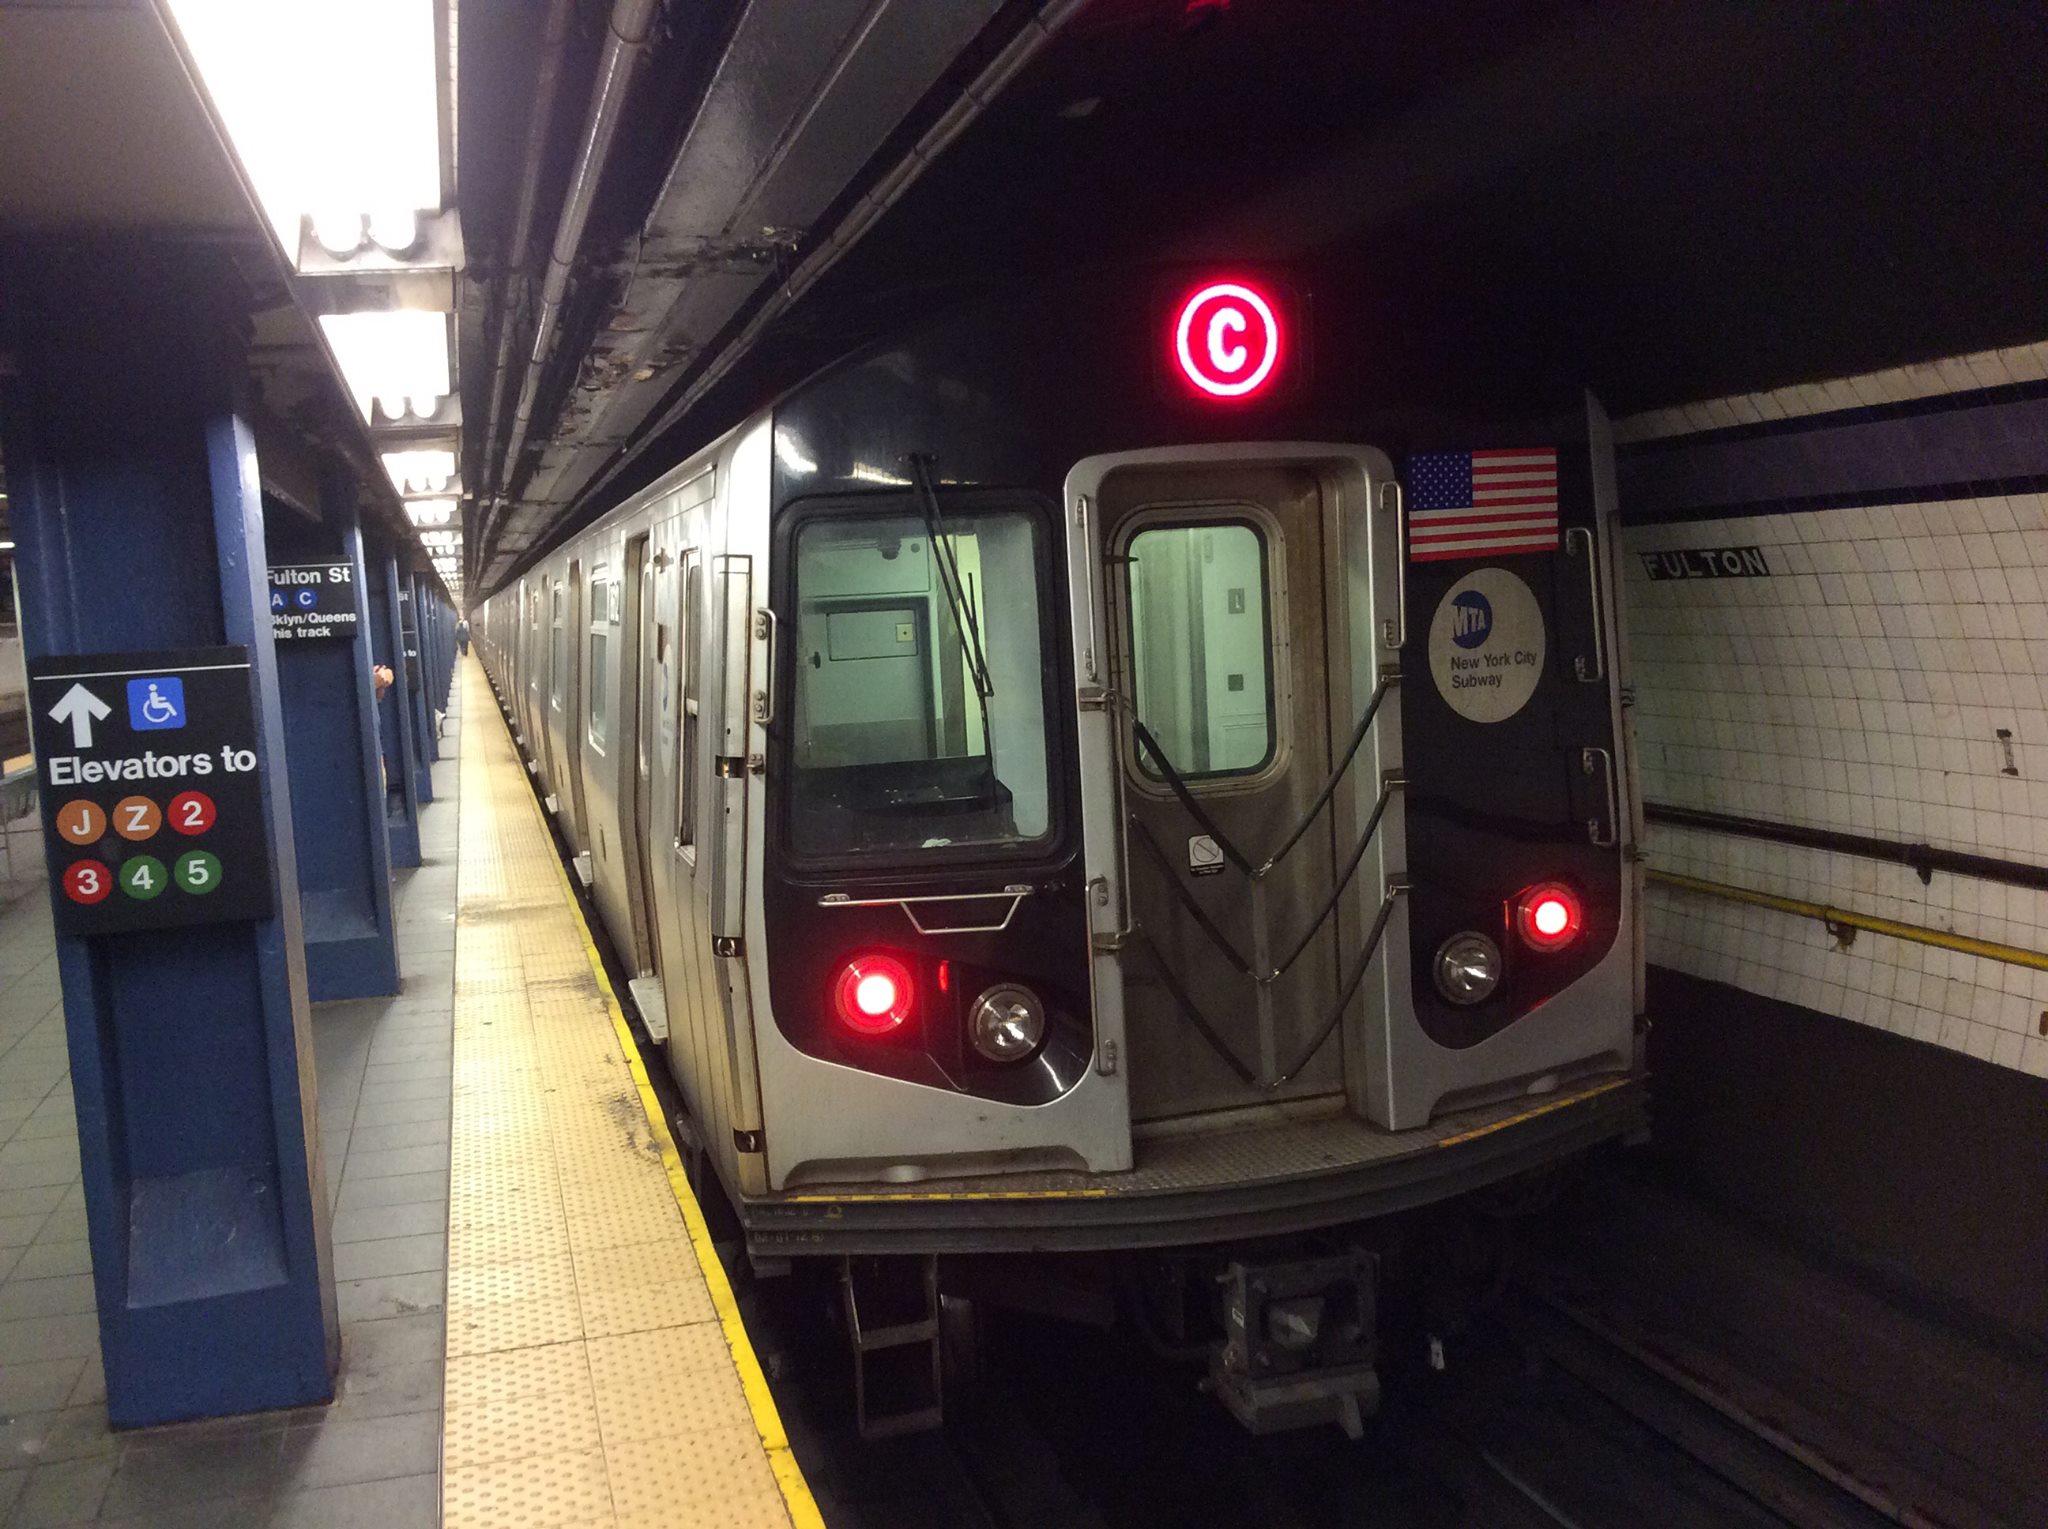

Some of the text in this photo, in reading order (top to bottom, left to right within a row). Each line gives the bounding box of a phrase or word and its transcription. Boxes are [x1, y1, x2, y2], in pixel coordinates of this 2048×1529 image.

[1207, 306, 1248, 374] C
[1643, 548, 1768, 578] FULTON
[267, 567, 351, 585] Fulton St
[271, 592, 312, 606] A C
[296, 626, 331, 638] track
[1450, 651, 1537, 671] New York City
[1451, 673, 1503, 689] Subway
[49, 745, 257, 786] Elevators to
[71, 800, 204, 835] J Z 2
[77, 859, 209, 895] 3 4 5
